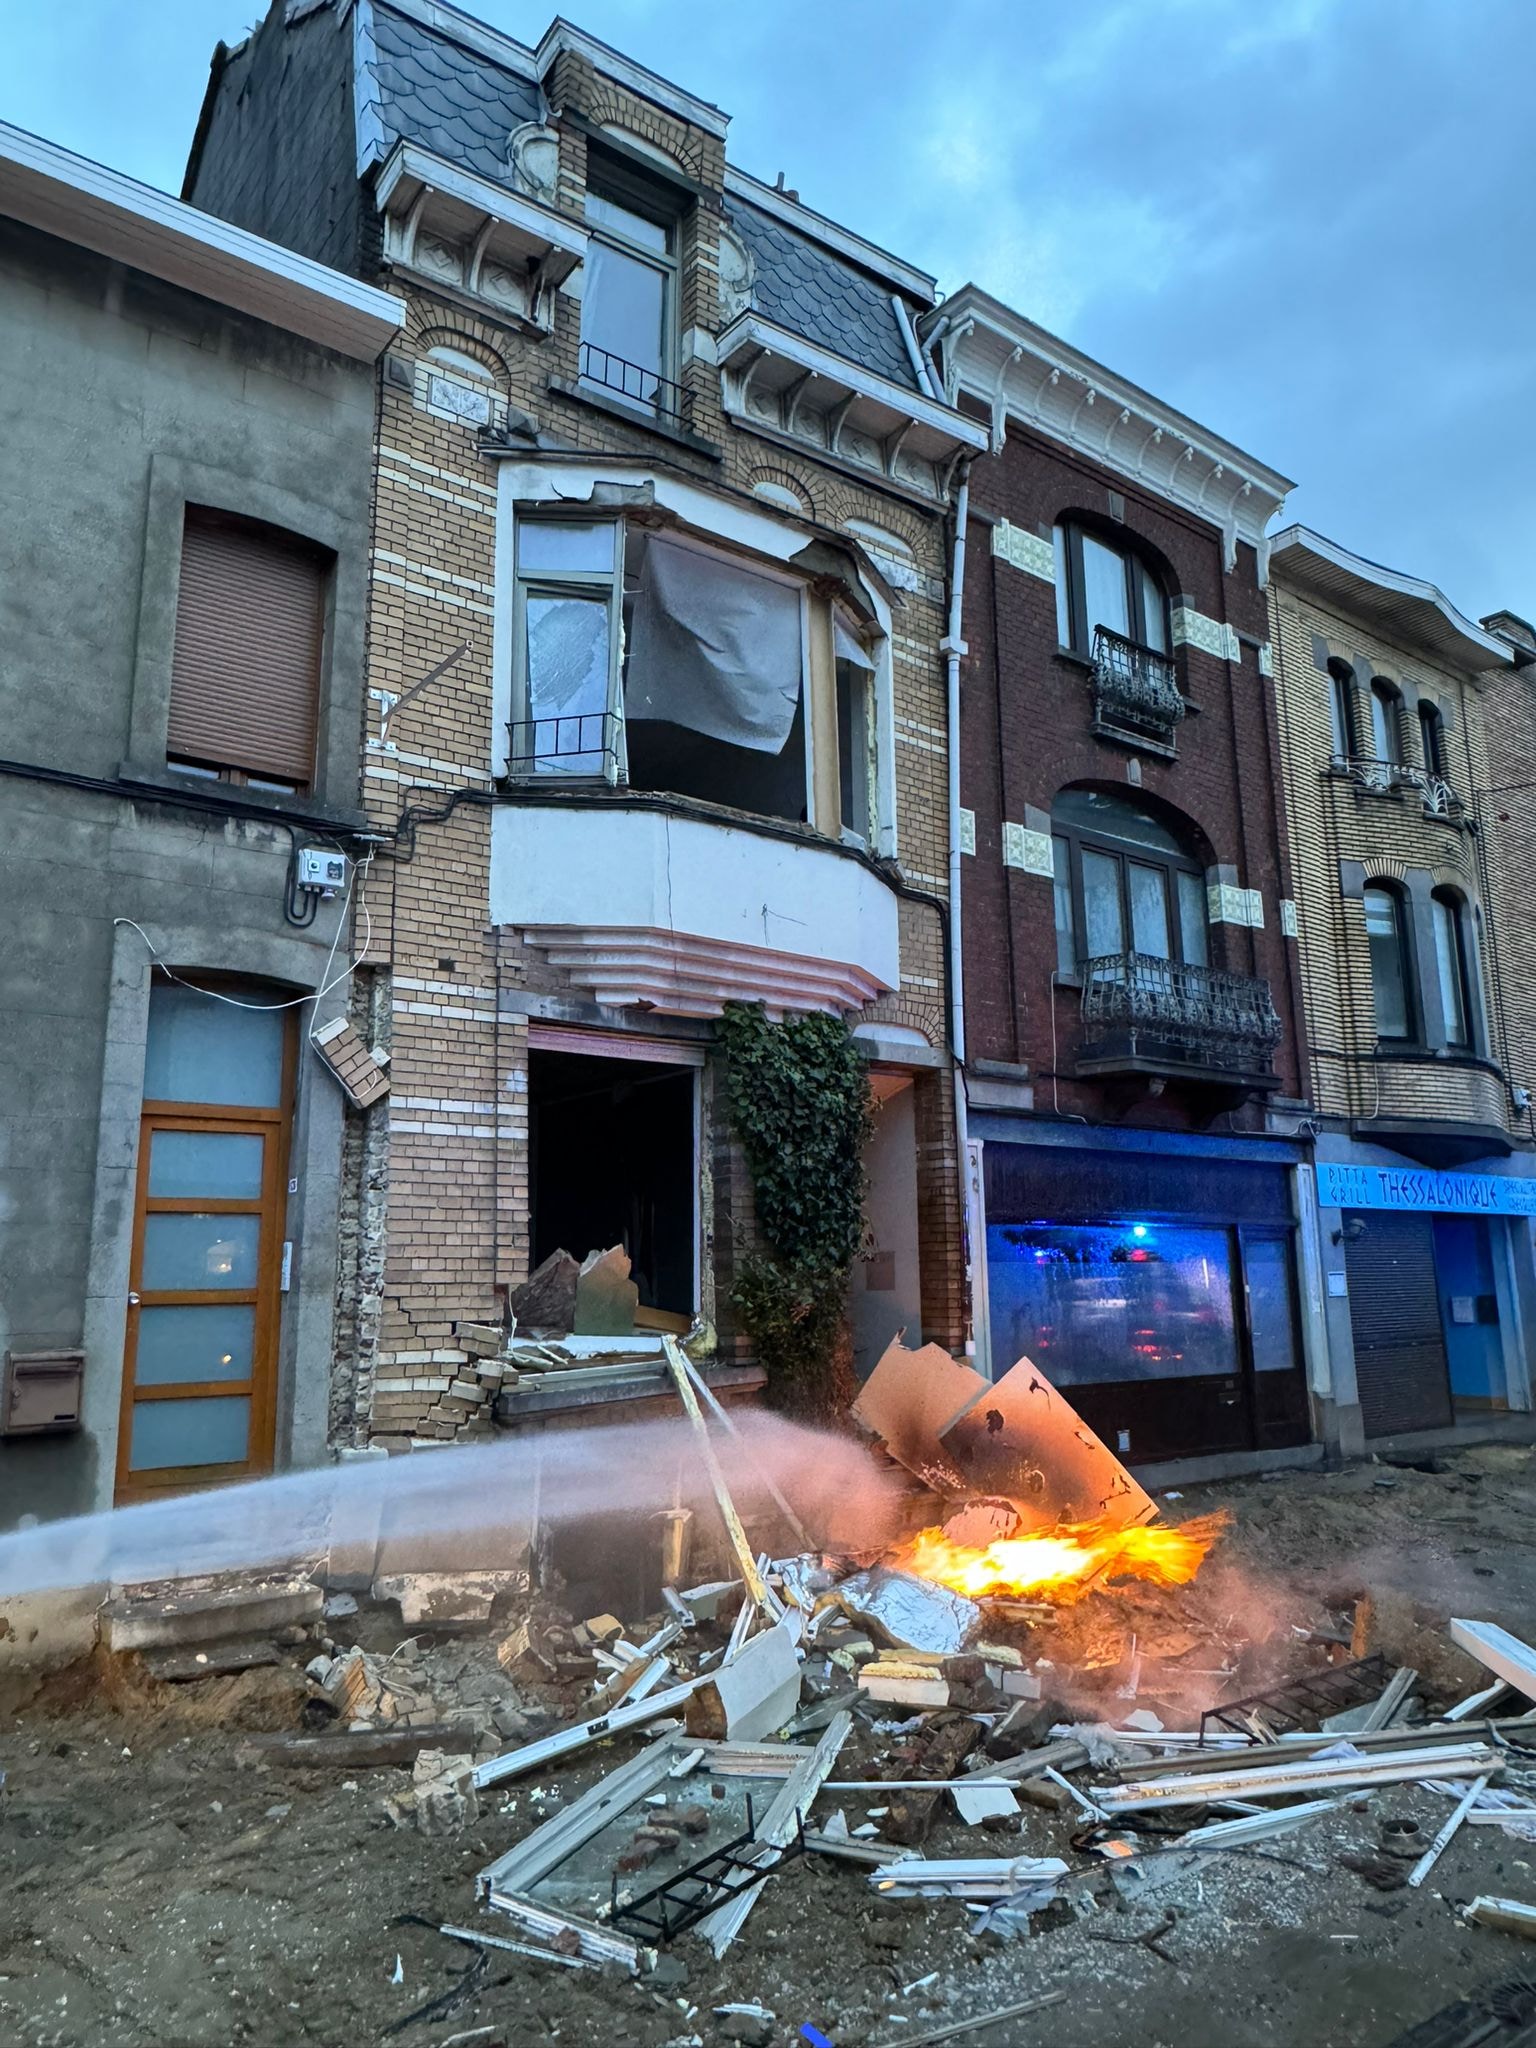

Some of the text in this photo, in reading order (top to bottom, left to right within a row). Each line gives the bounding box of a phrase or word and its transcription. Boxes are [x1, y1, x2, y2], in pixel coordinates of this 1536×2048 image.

[1329, 1167, 1367, 1184] PITTA
[1331, 1186, 1372, 1204] GRILL
[1379, 1174, 1499, 1207] THESSALONIQUE
